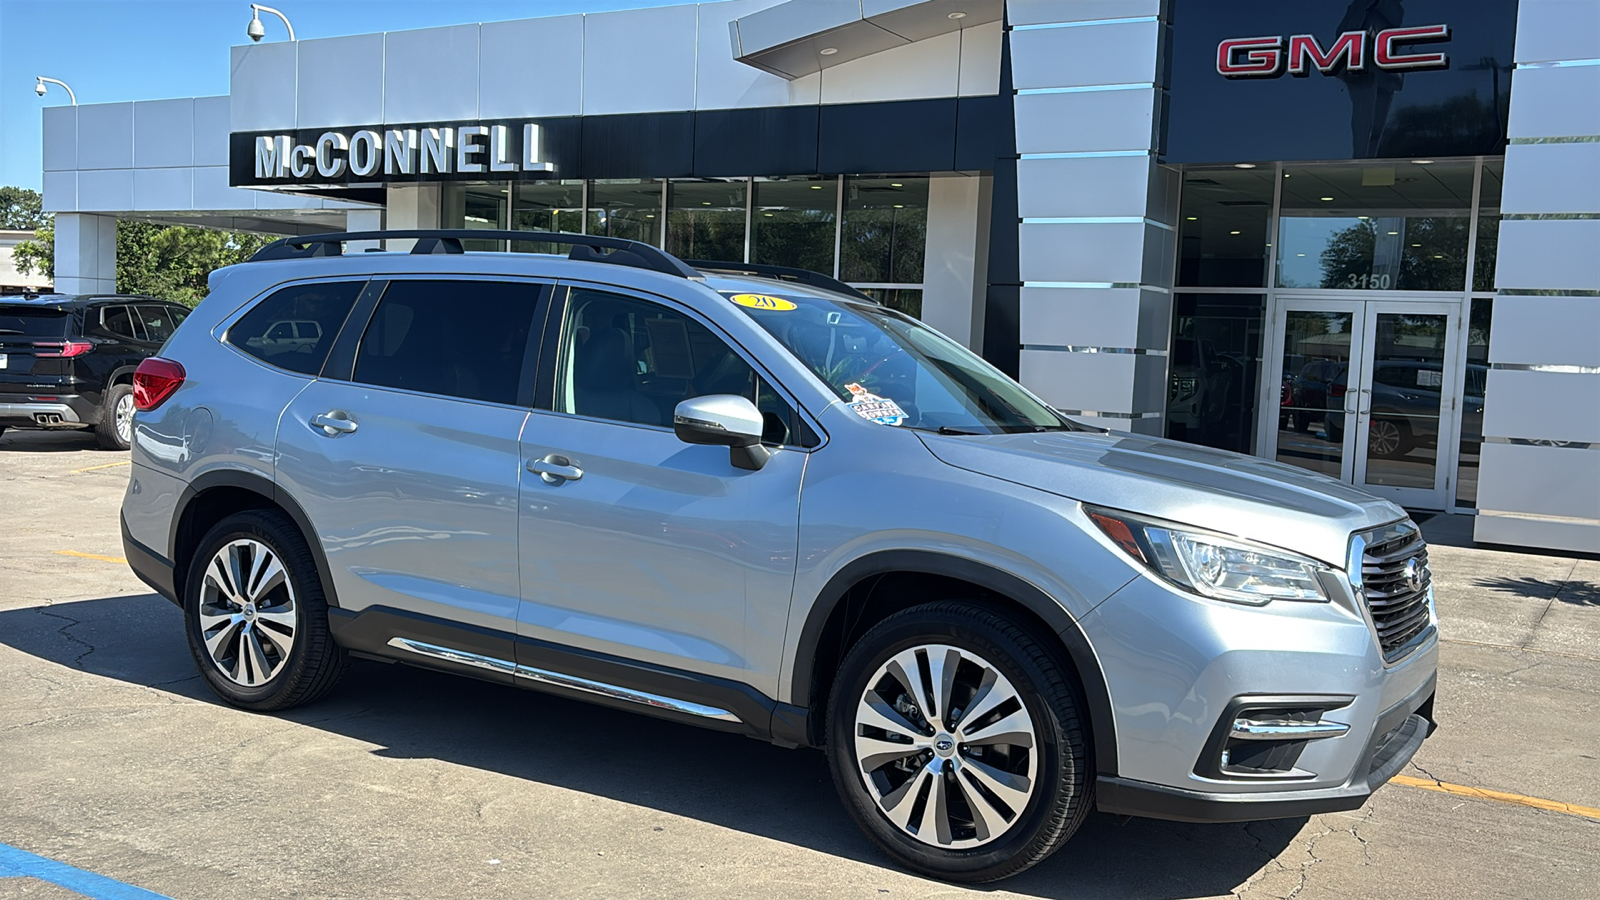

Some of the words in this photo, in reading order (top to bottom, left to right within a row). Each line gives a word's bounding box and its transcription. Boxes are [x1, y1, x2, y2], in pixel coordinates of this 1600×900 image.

[1216, 23, 1448, 76] GMC
[254, 123, 554, 179] McCONNELL
[1347, 272, 1391, 290] 3150
[748, 295, 777, 308] 20
